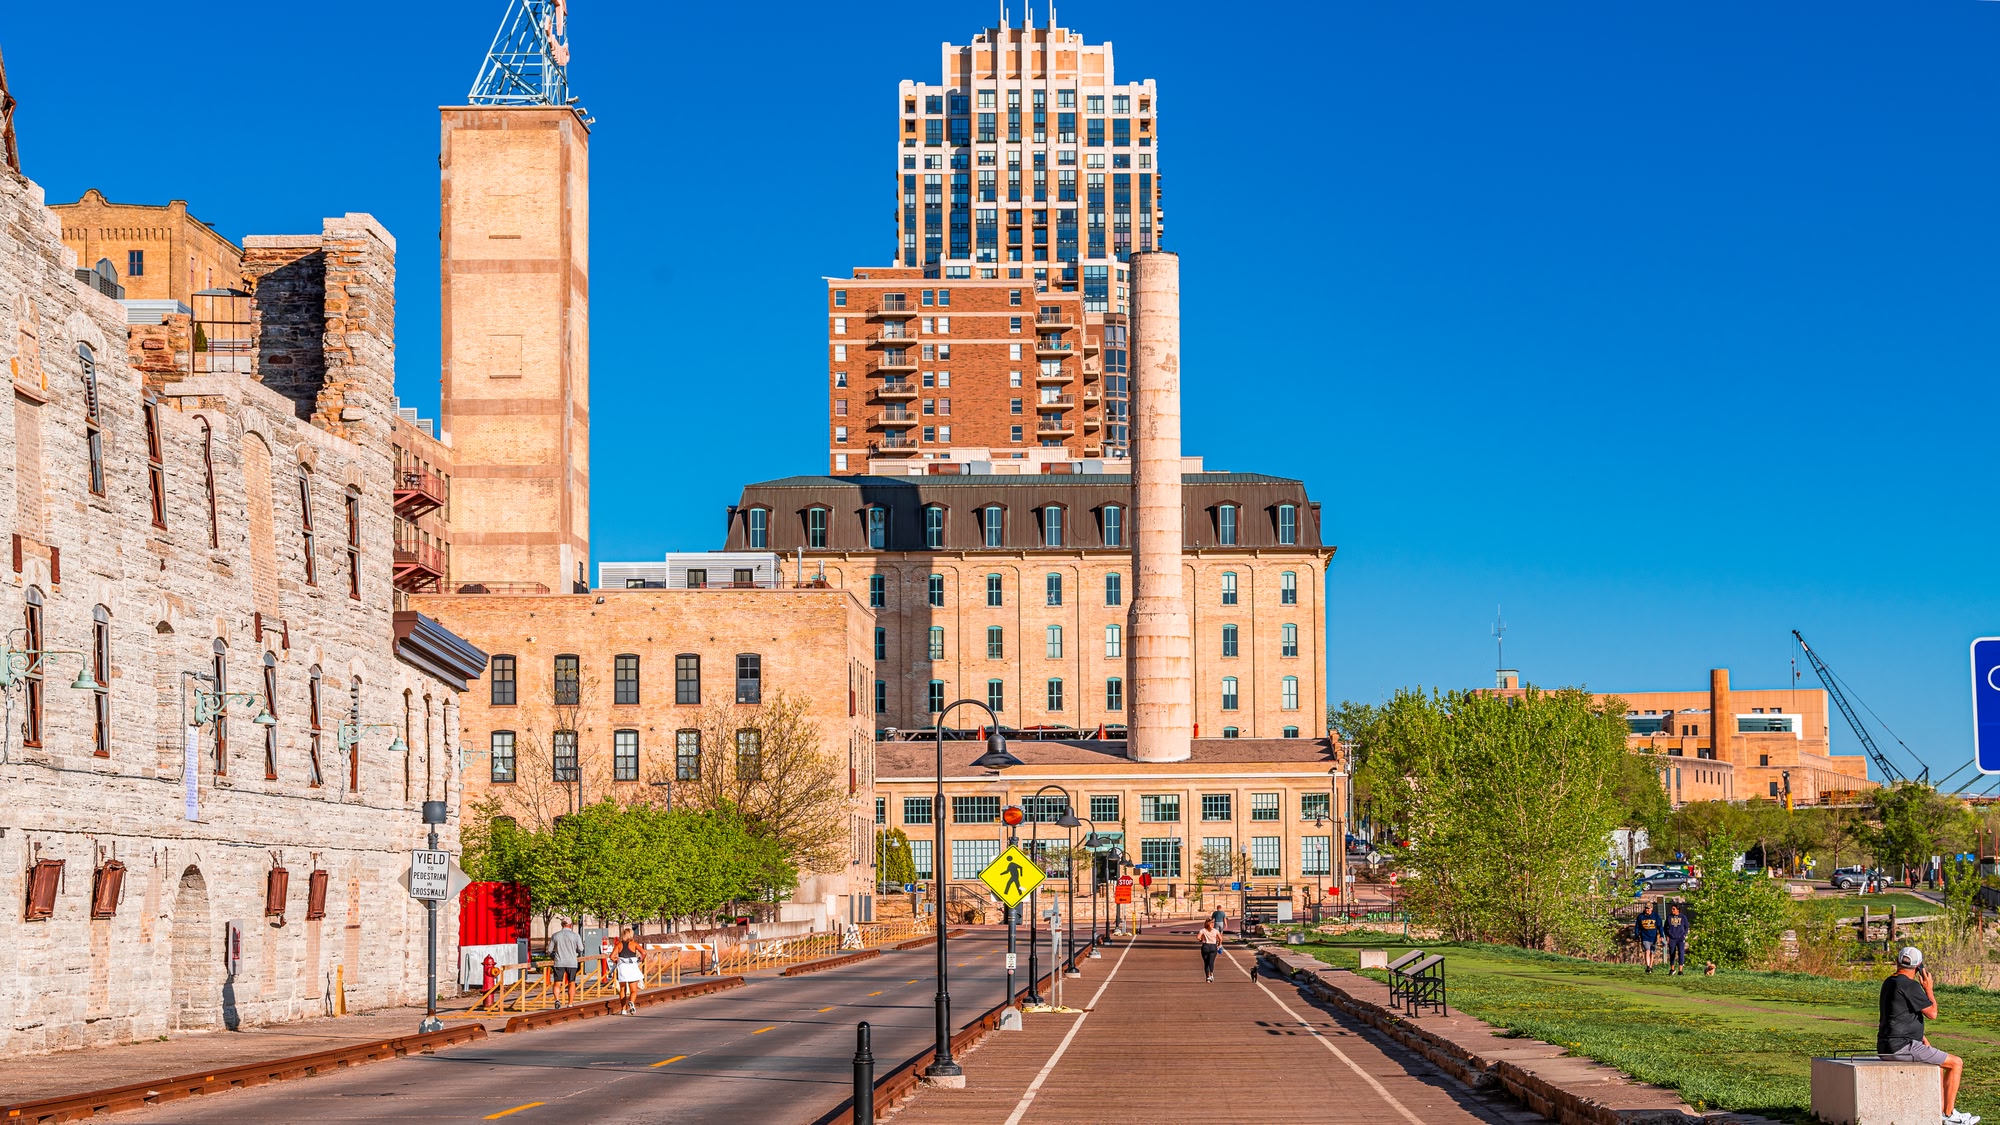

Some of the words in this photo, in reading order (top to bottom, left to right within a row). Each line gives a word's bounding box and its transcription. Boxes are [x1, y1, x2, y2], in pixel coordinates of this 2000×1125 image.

[416, 853, 446, 864] YIELD
[413, 872, 446, 880] PEDESTRIAN
[412, 888, 445, 896] CROSSWALK
